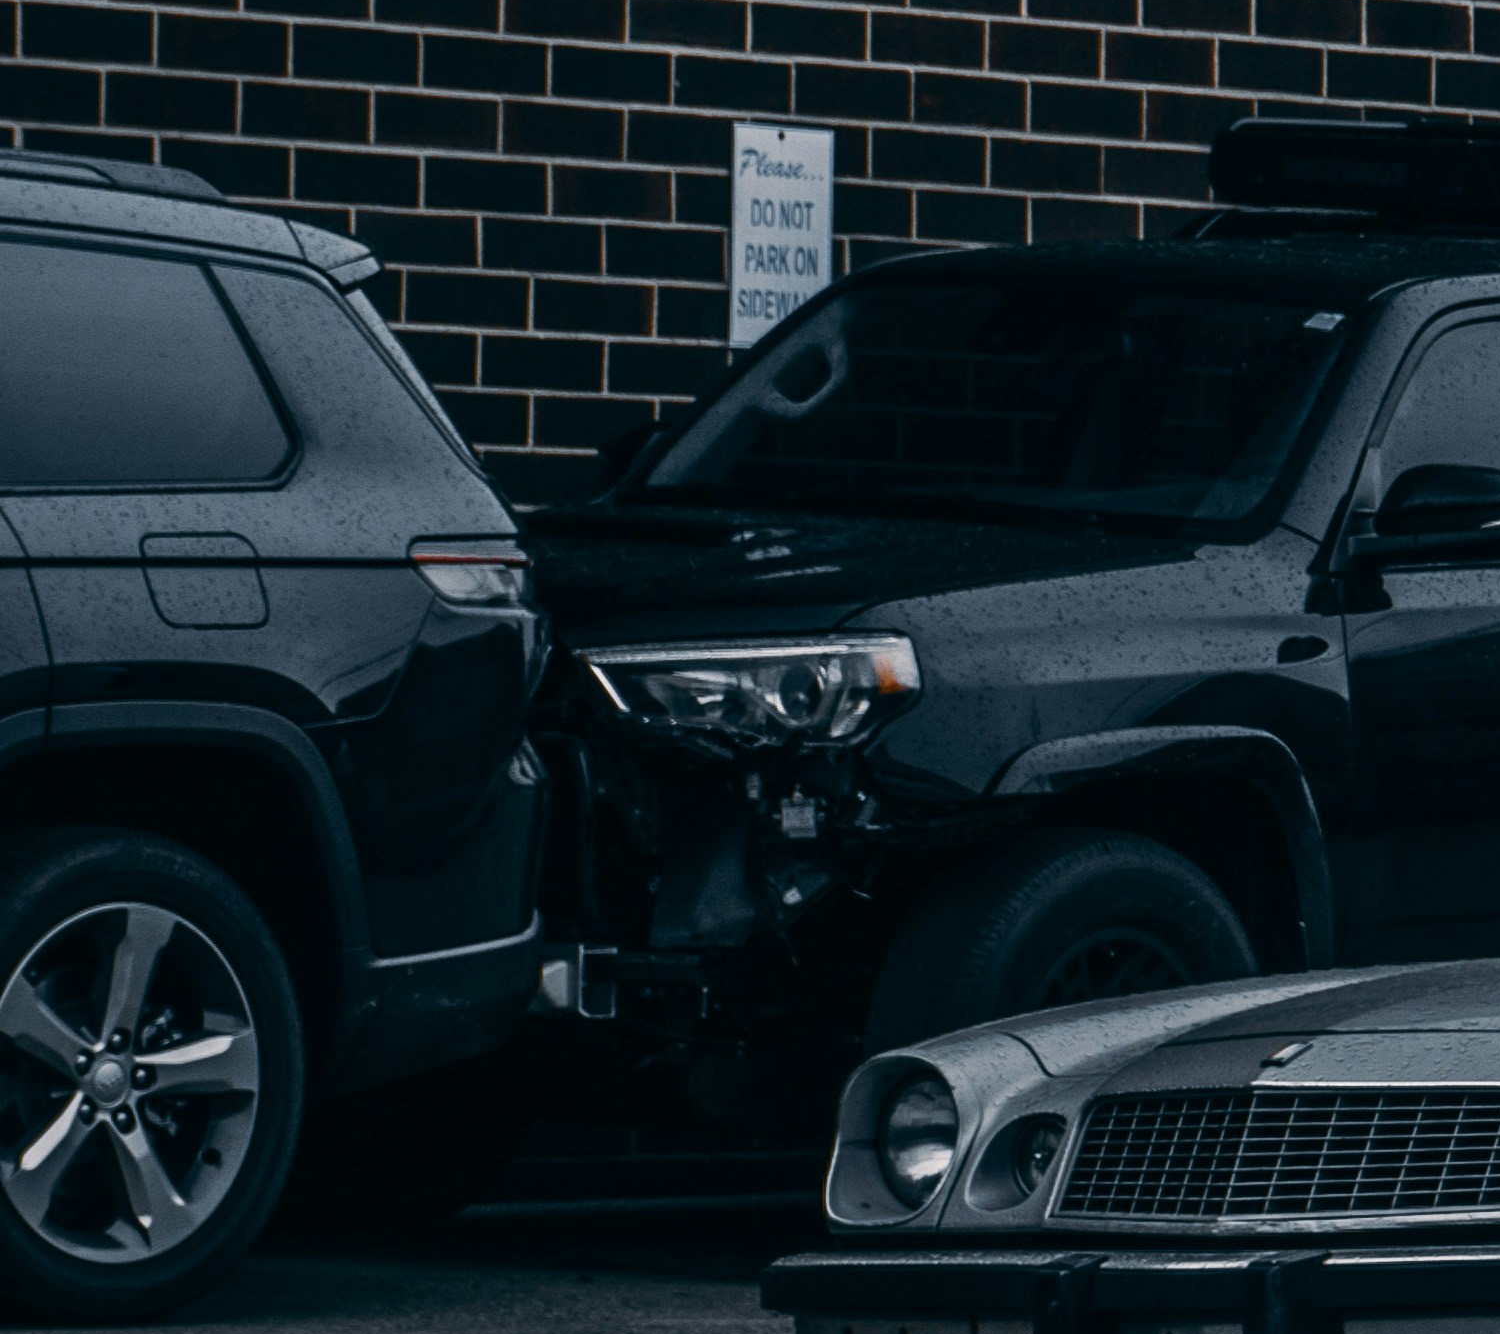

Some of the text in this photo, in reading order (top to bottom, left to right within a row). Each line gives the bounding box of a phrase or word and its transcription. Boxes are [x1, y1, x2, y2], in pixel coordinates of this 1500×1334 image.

[739, 148, 824, 183] Please...
[750, 198, 814, 231] DO NOT
[744, 244, 818, 277] PARK ON
